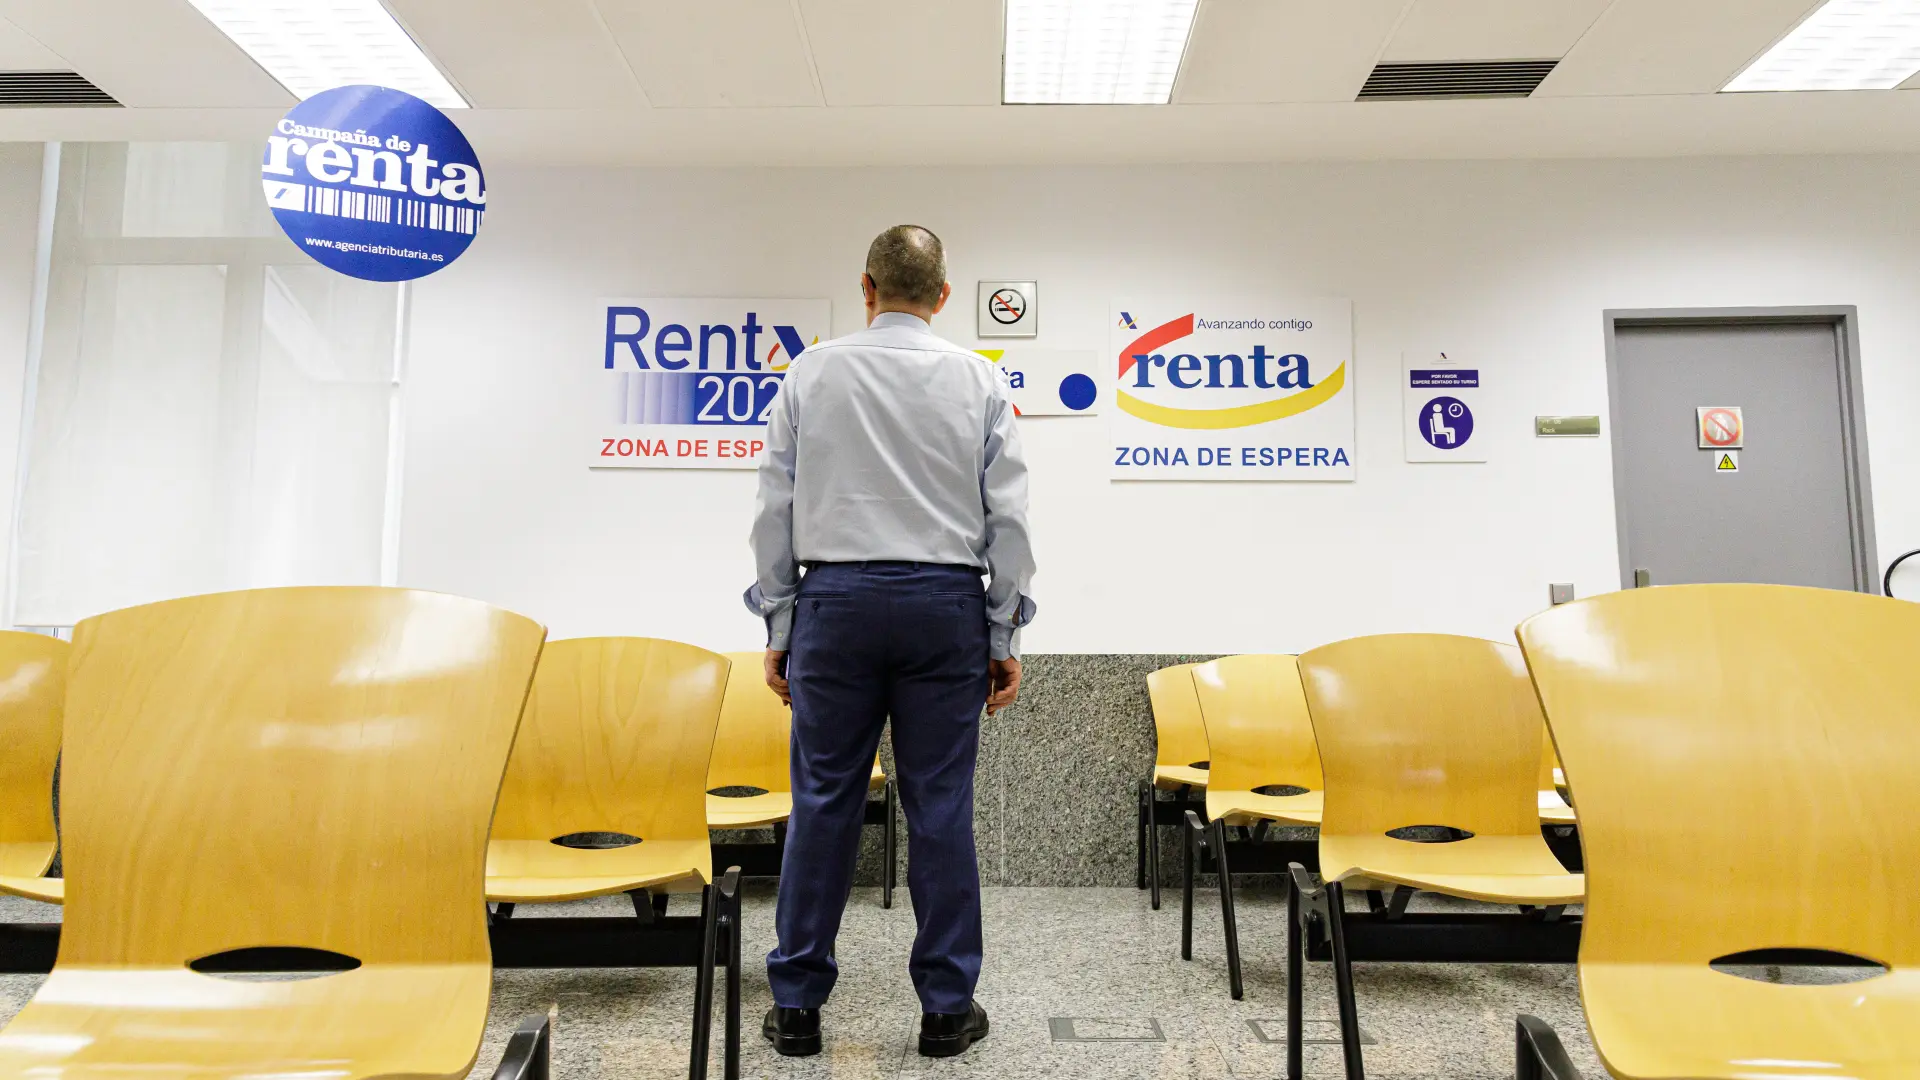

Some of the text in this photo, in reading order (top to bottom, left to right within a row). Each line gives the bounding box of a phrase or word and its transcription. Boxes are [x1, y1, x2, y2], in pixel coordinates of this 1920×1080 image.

[277, 118, 411, 153] Campaña de
[262, 136, 487, 205] renta
[305, 236, 445, 263] www.agenciatributaria.es
[1197, 318, 1314, 335] Avanzando contigo
[1131, 344, 1315, 390] renta
[696, 375, 783, 423] 202
[600, 439, 764, 458] ZONA DE ESP
[1114, 447, 1350, 467] ZONA DE ESPERA
